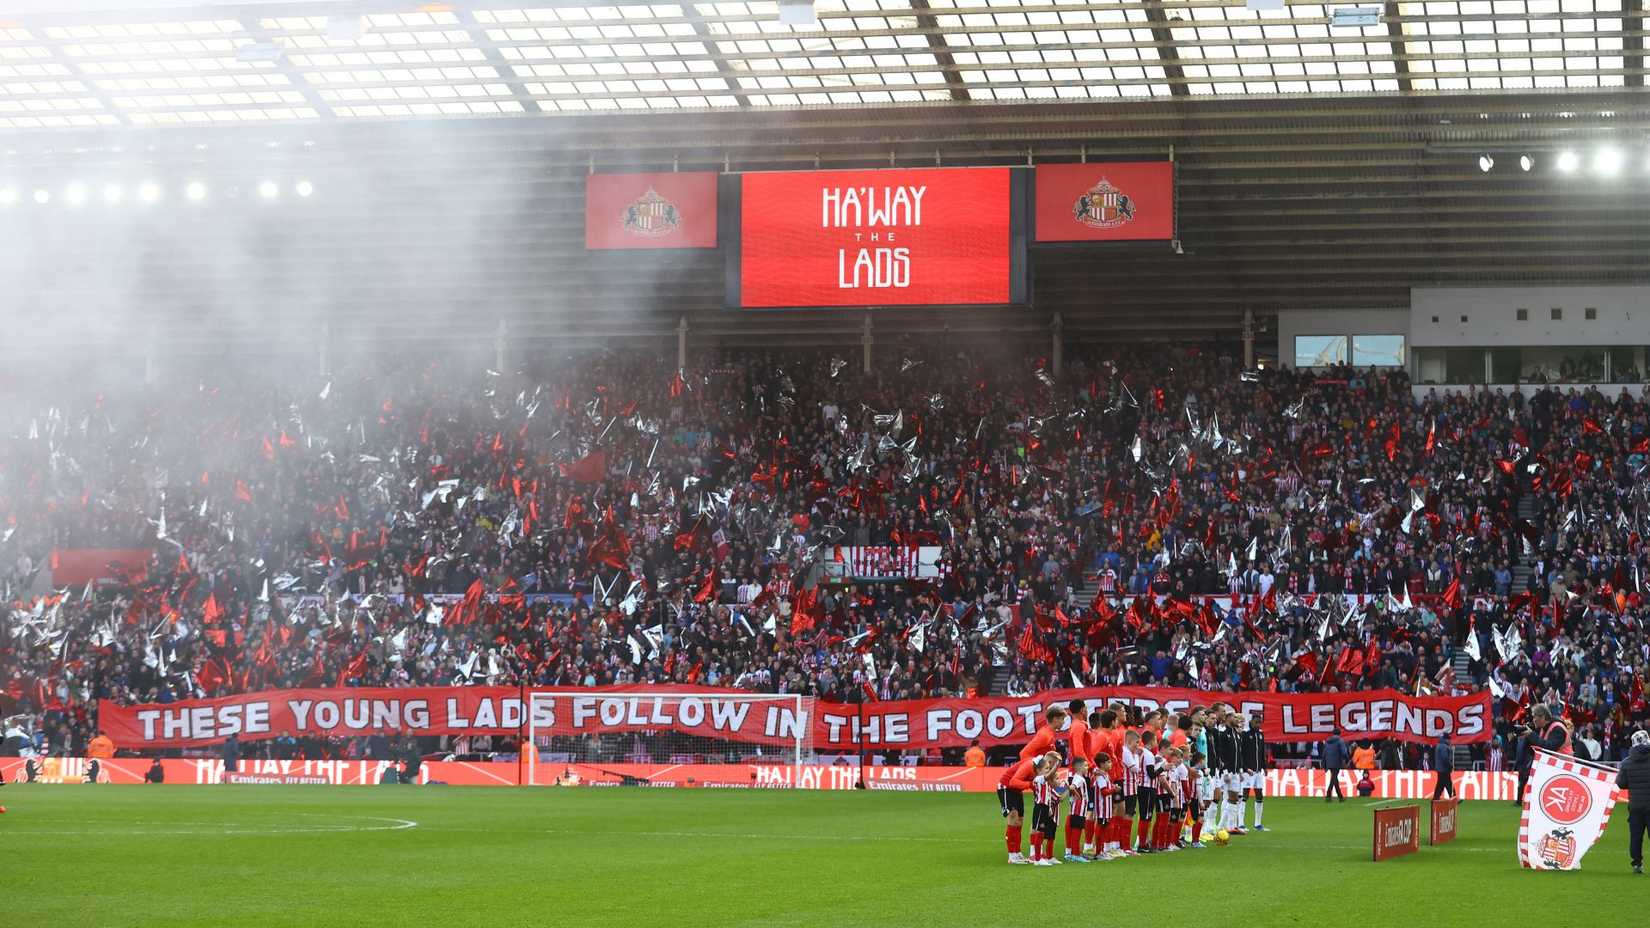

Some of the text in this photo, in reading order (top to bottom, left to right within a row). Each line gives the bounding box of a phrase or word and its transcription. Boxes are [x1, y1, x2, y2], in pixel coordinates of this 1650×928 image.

[822, 185, 927, 228] HA'WAY
[854, 232, 896, 242] THE
[839, 247, 911, 288] LADS
[137, 701, 270, 740] THESE
[288, 699, 430, 730] YOUNG
[446, 697, 556, 728] LADS
[572, 697, 750, 732] FOLLOW
[764, 706, 808, 740] IN
[823, 713, 910, 743] THE
[1282, 700, 1485, 737] LEGENDS
